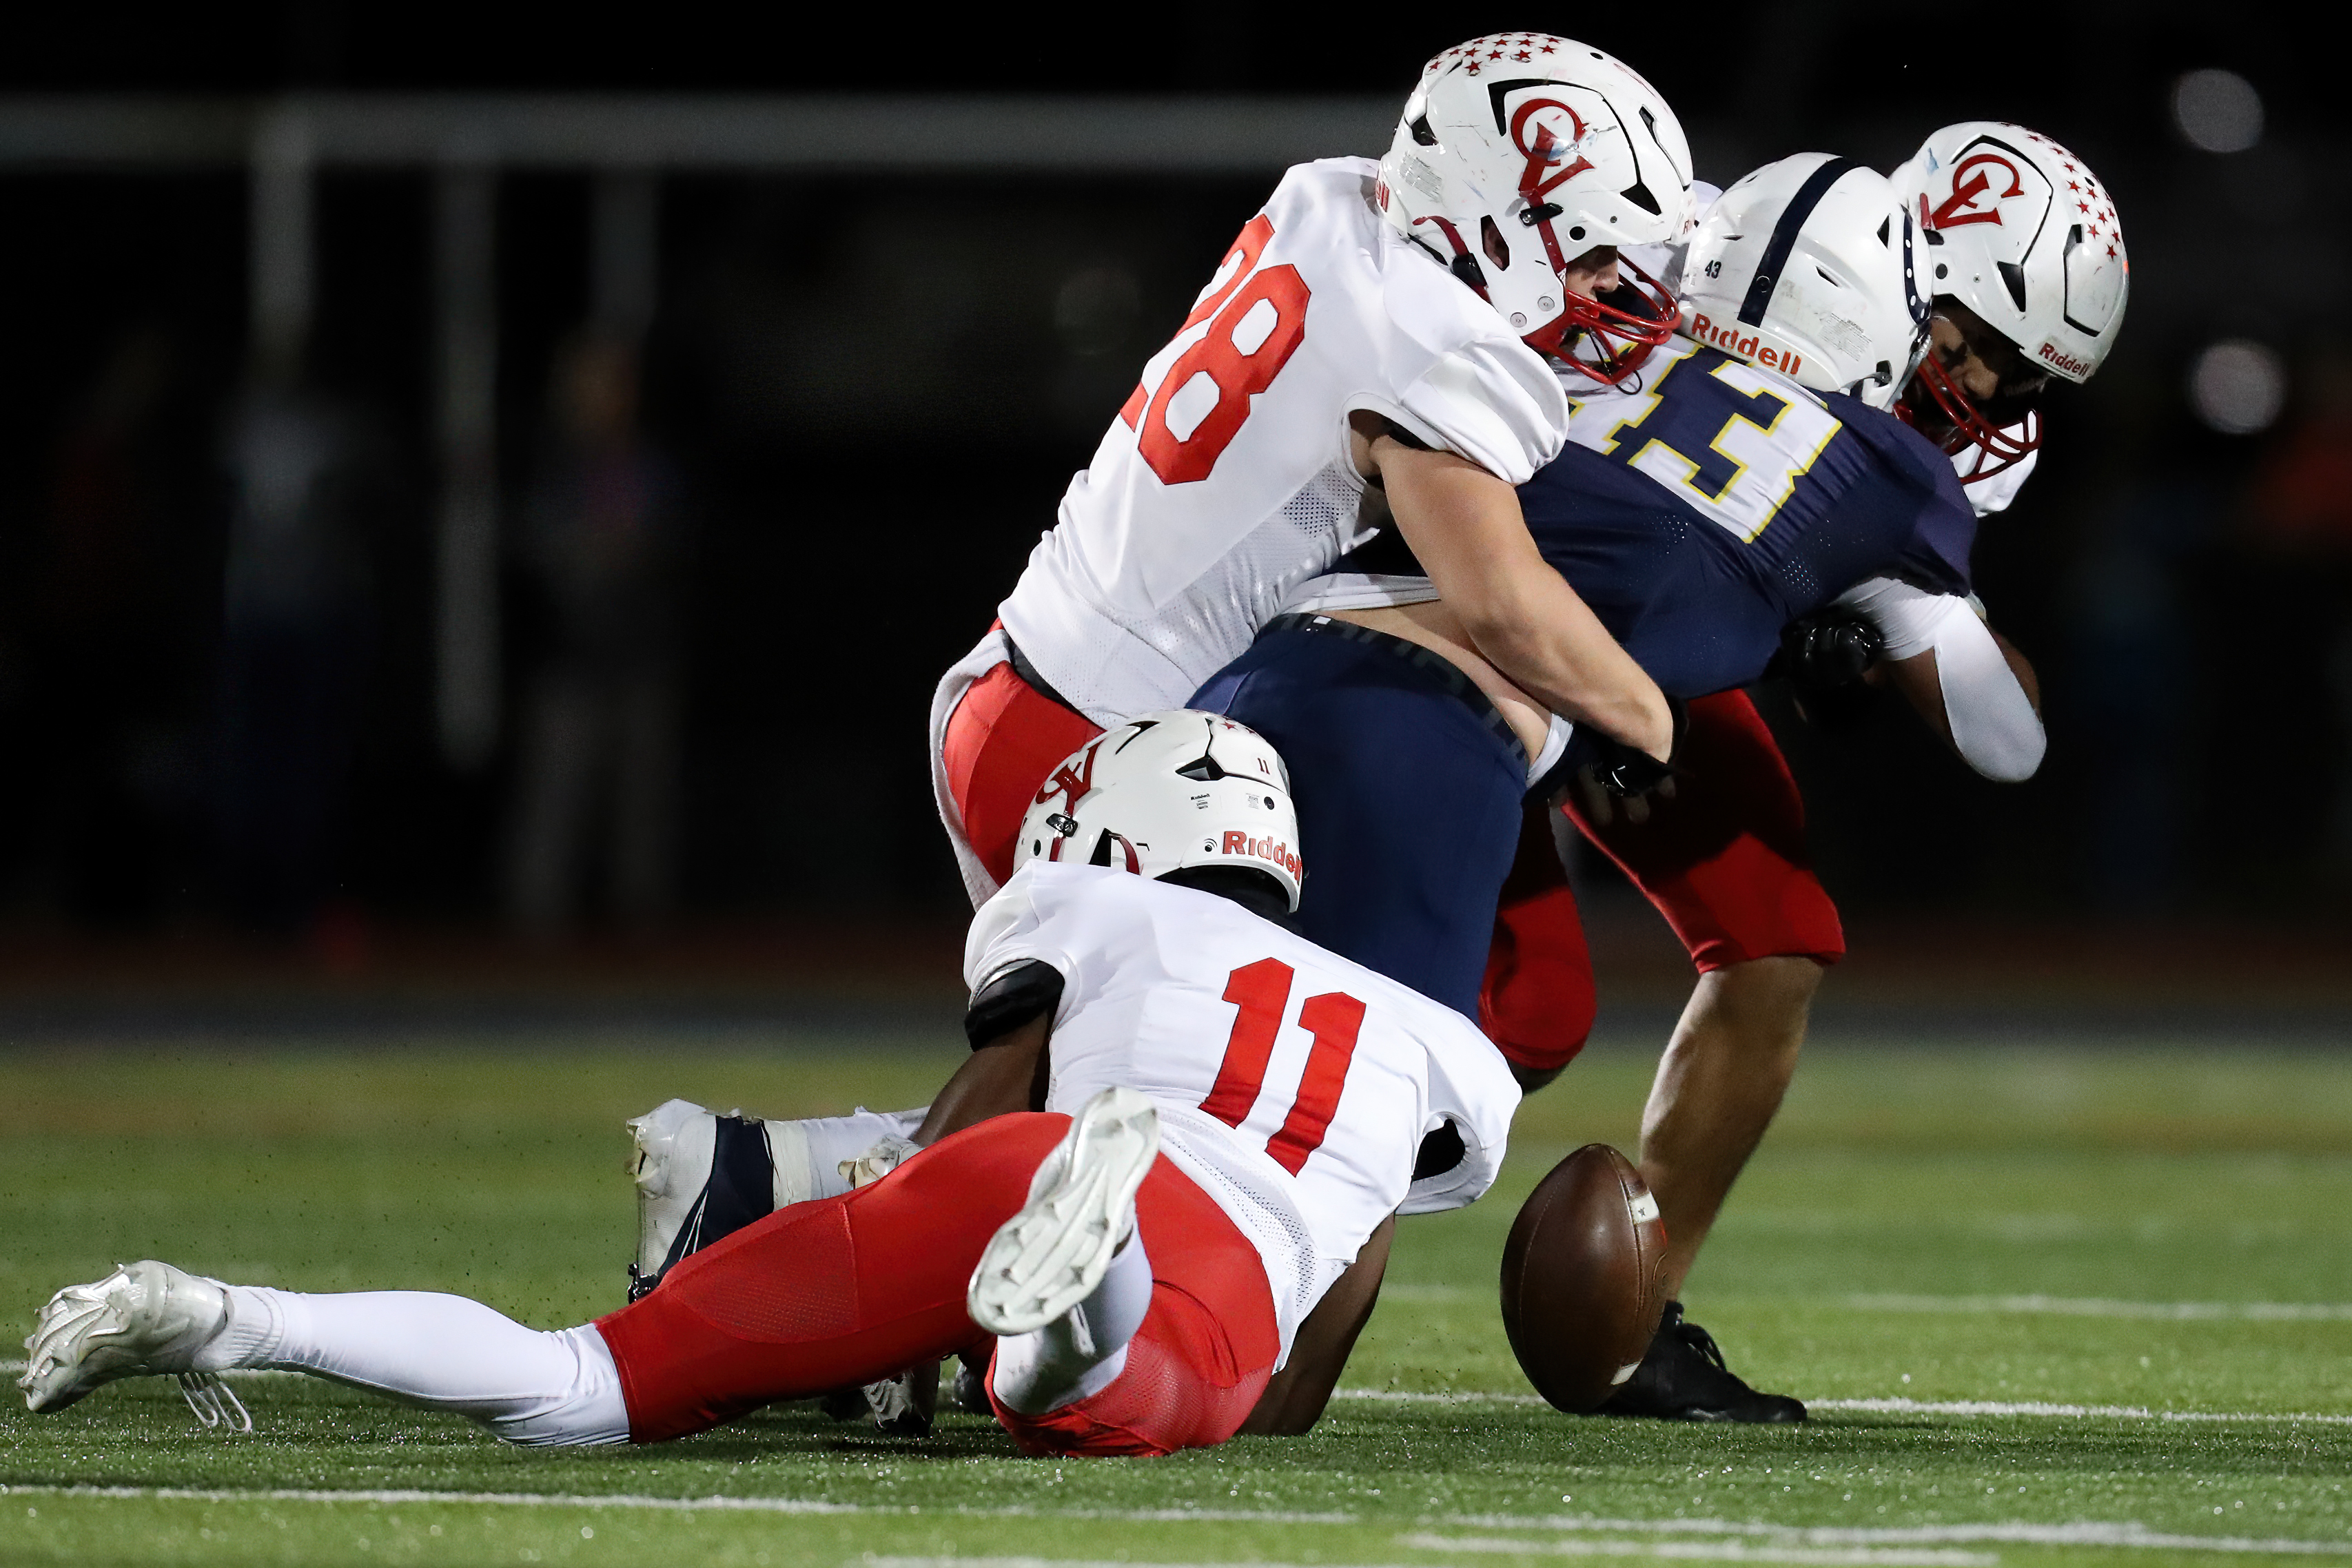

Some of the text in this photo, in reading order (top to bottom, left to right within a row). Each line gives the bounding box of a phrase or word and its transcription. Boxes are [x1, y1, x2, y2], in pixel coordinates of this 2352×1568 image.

[1704, 260, 1721, 279] 43
[1691, 313, 1802, 375] Riddell
[2038, 342, 2092, 376] Riddell
[1257, 758, 1270, 775] 11
[1198, 957, 1366, 1177] 11
